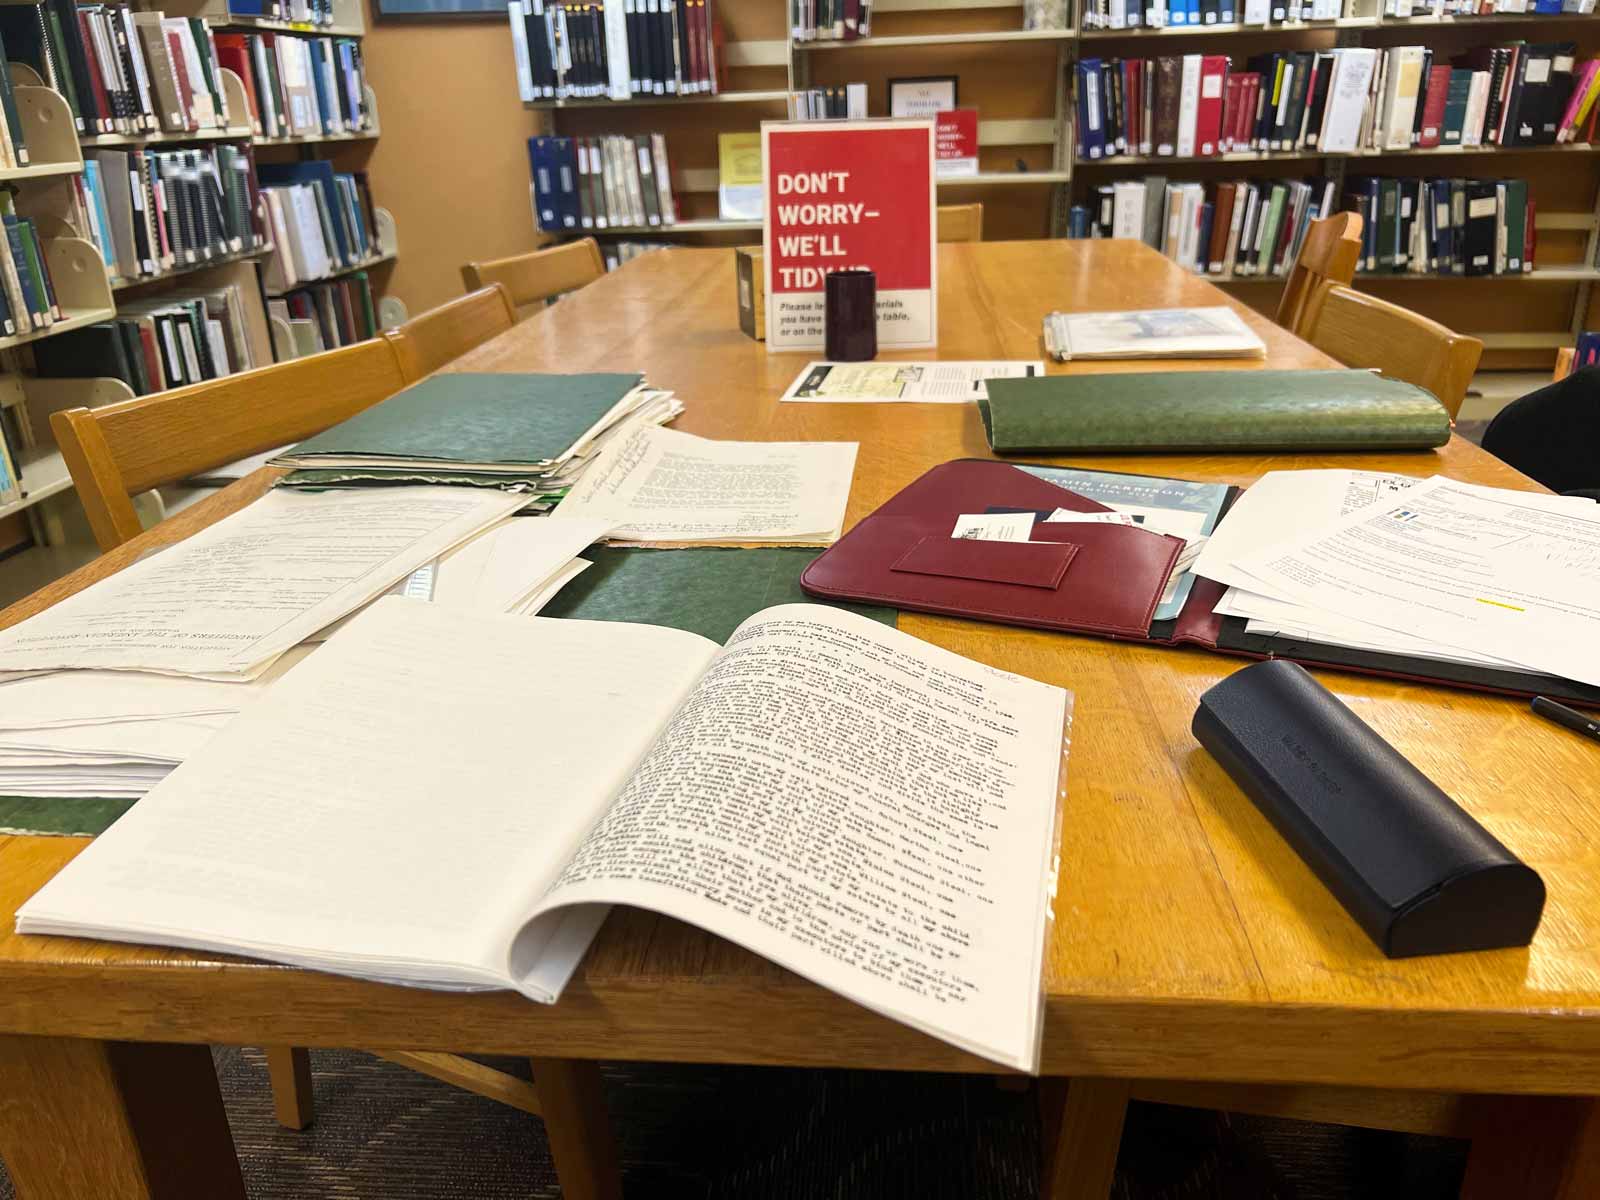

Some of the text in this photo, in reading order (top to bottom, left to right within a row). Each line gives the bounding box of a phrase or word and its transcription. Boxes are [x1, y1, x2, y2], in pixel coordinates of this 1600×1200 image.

[777, 171, 850, 195] DON'T
[777, 234, 847, 257] WE'LL
[779, 302, 813, 312] Please
[779, 317, 797, 326] you
[799, 316, 823, 324] have
[807, 328, 823, 337] the
[1099, 483, 1186, 498] HARRISON
